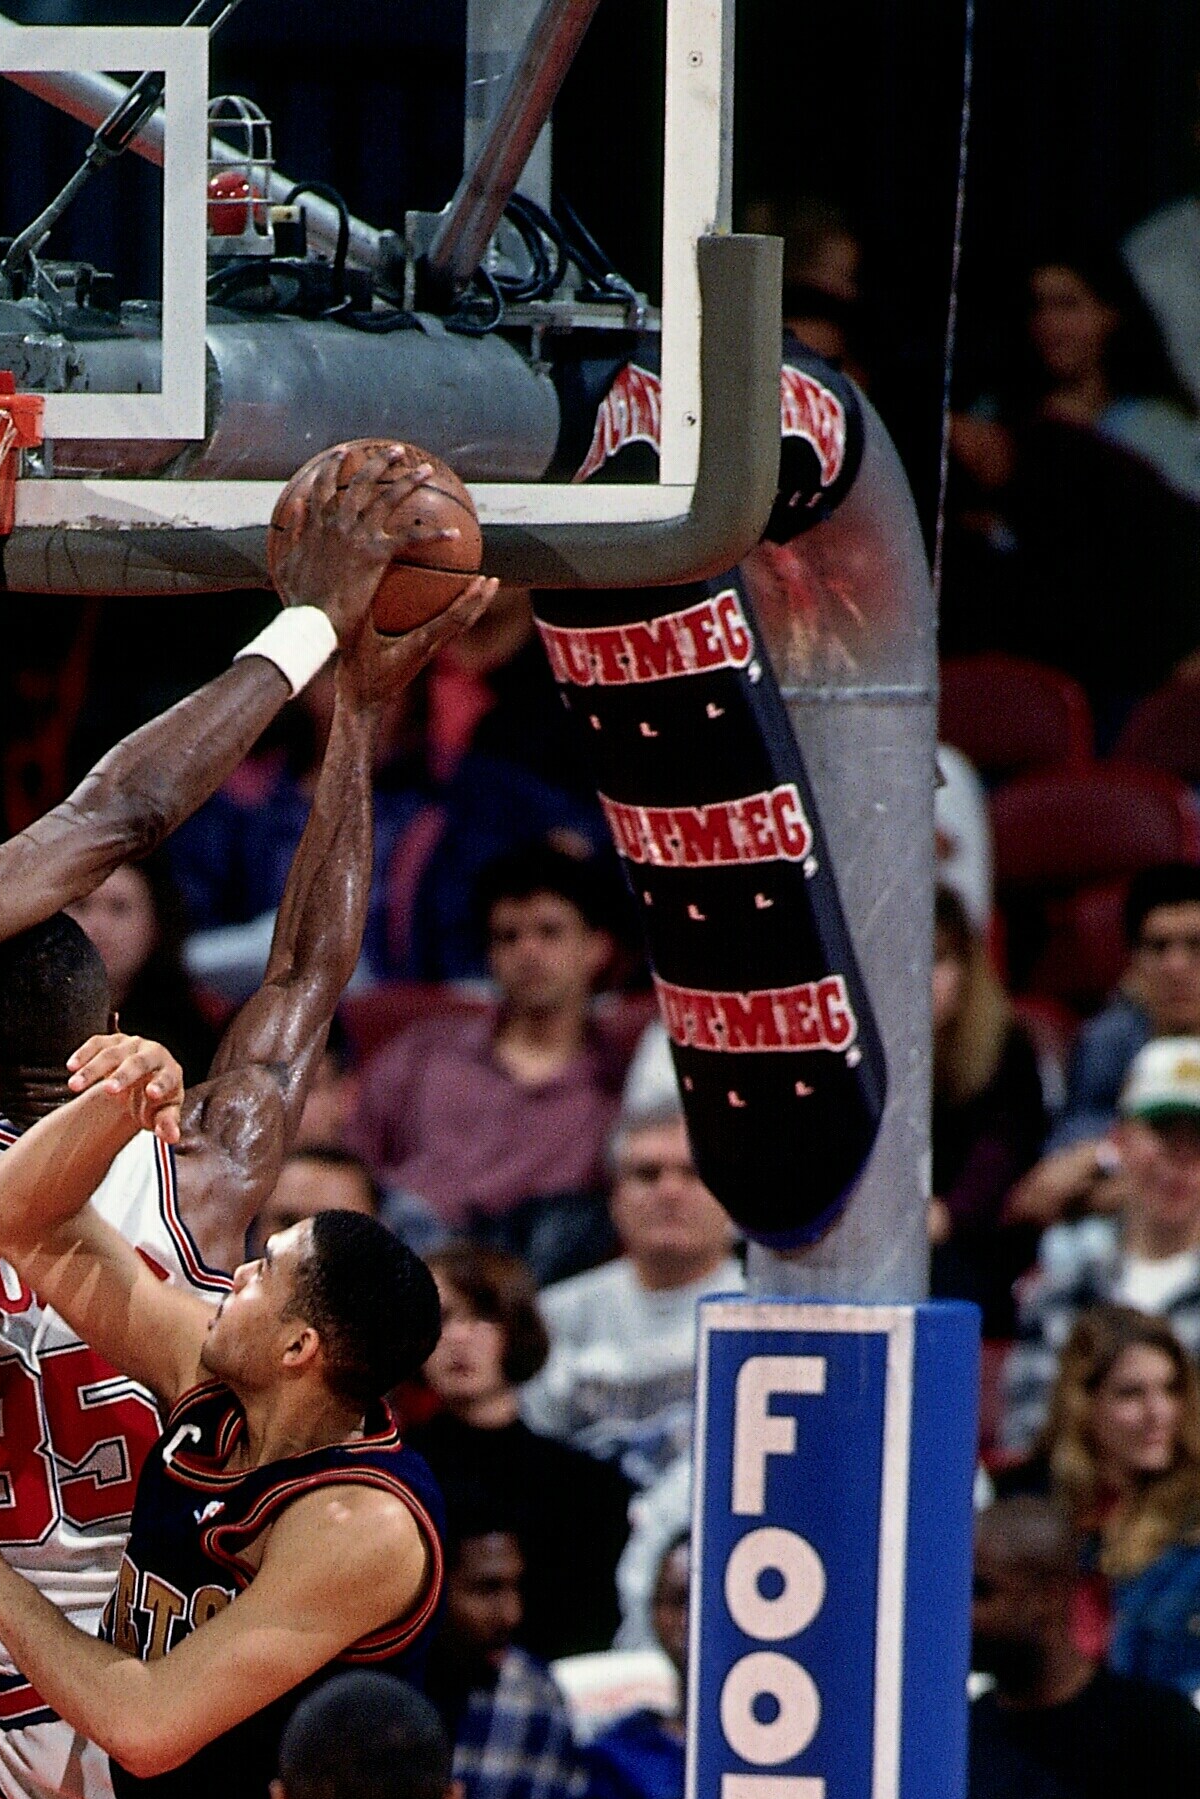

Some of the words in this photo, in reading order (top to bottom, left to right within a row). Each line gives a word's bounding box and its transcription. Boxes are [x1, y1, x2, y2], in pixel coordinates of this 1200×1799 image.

[534, 588, 754, 688] UTMEG
[598, 783, 812, 868] UTMEG
[651, 974, 857, 1053] UTMEG
